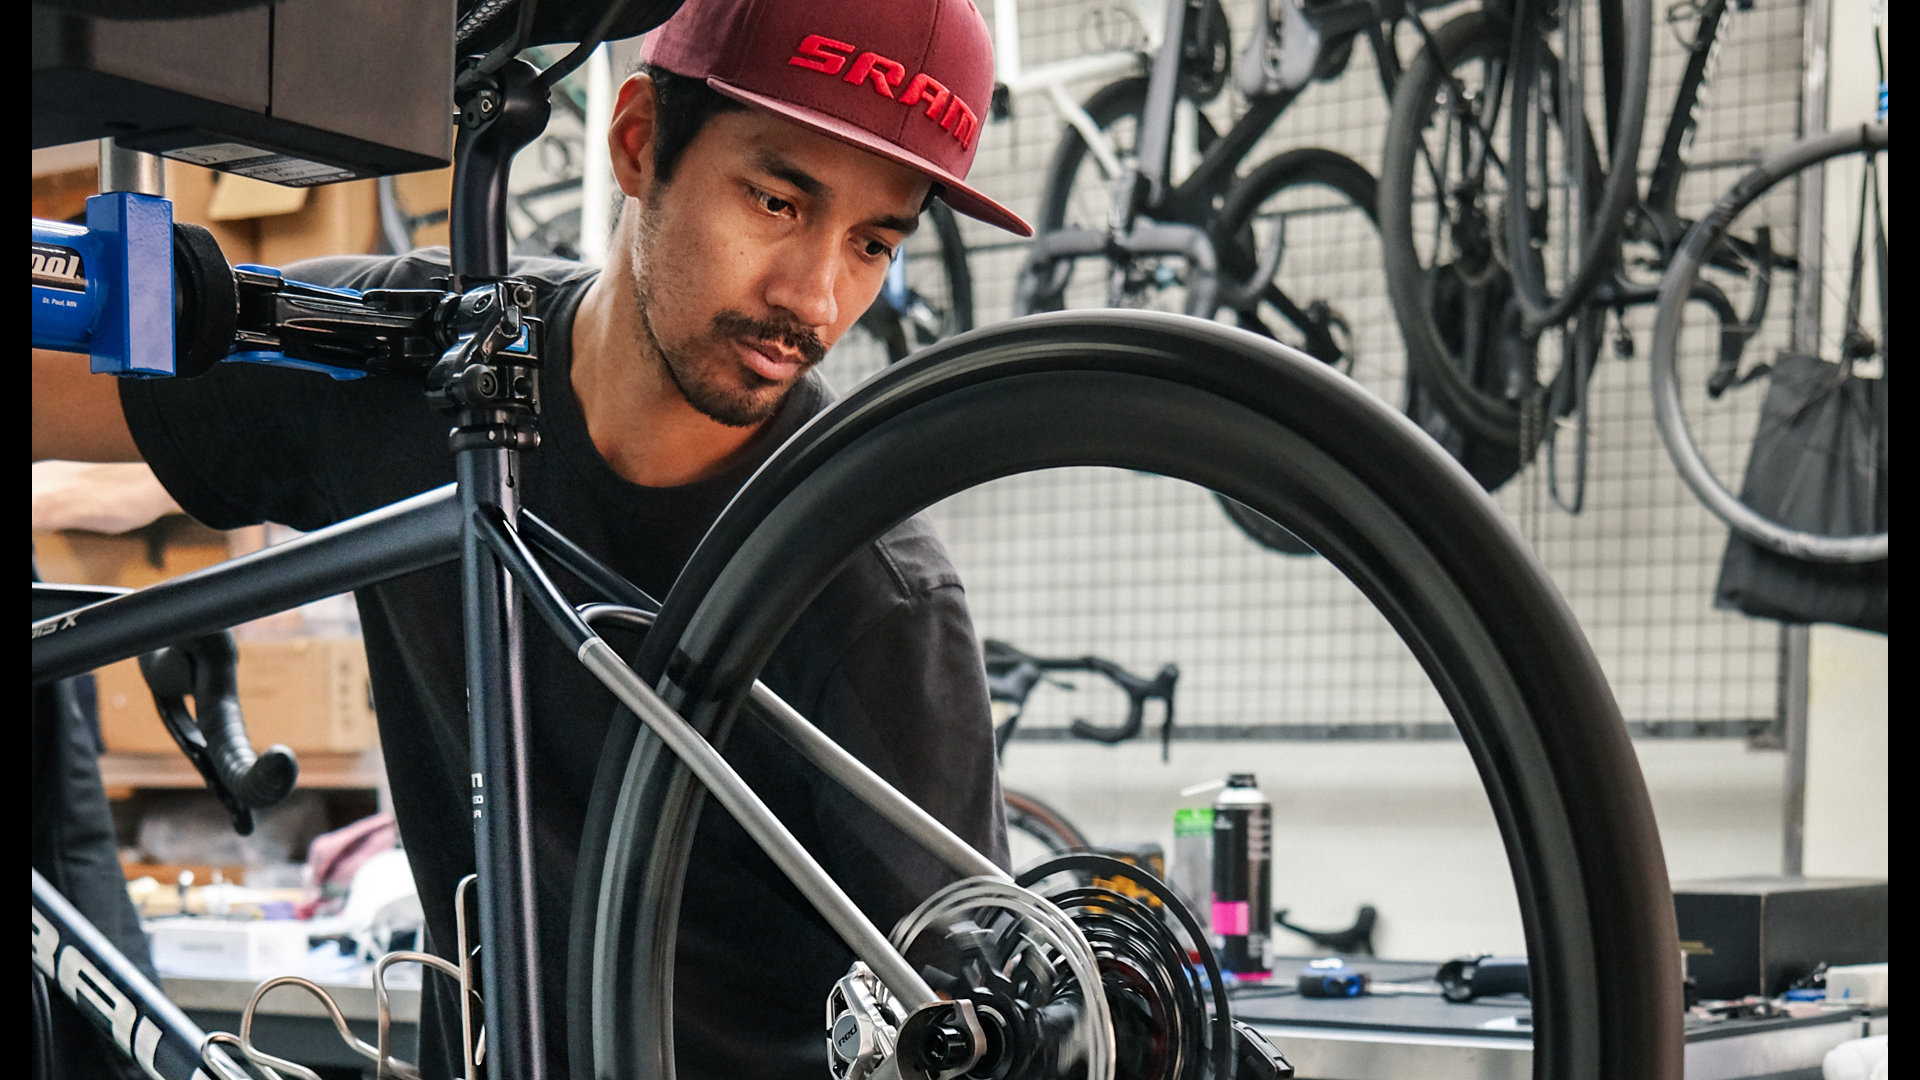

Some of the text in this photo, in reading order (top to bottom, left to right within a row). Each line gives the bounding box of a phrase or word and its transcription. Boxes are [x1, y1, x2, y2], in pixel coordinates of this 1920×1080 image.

[788, 34, 977, 150] SRAM
[52, 298, 65, 307] Paul,
[66, 300, 77, 308] MN
